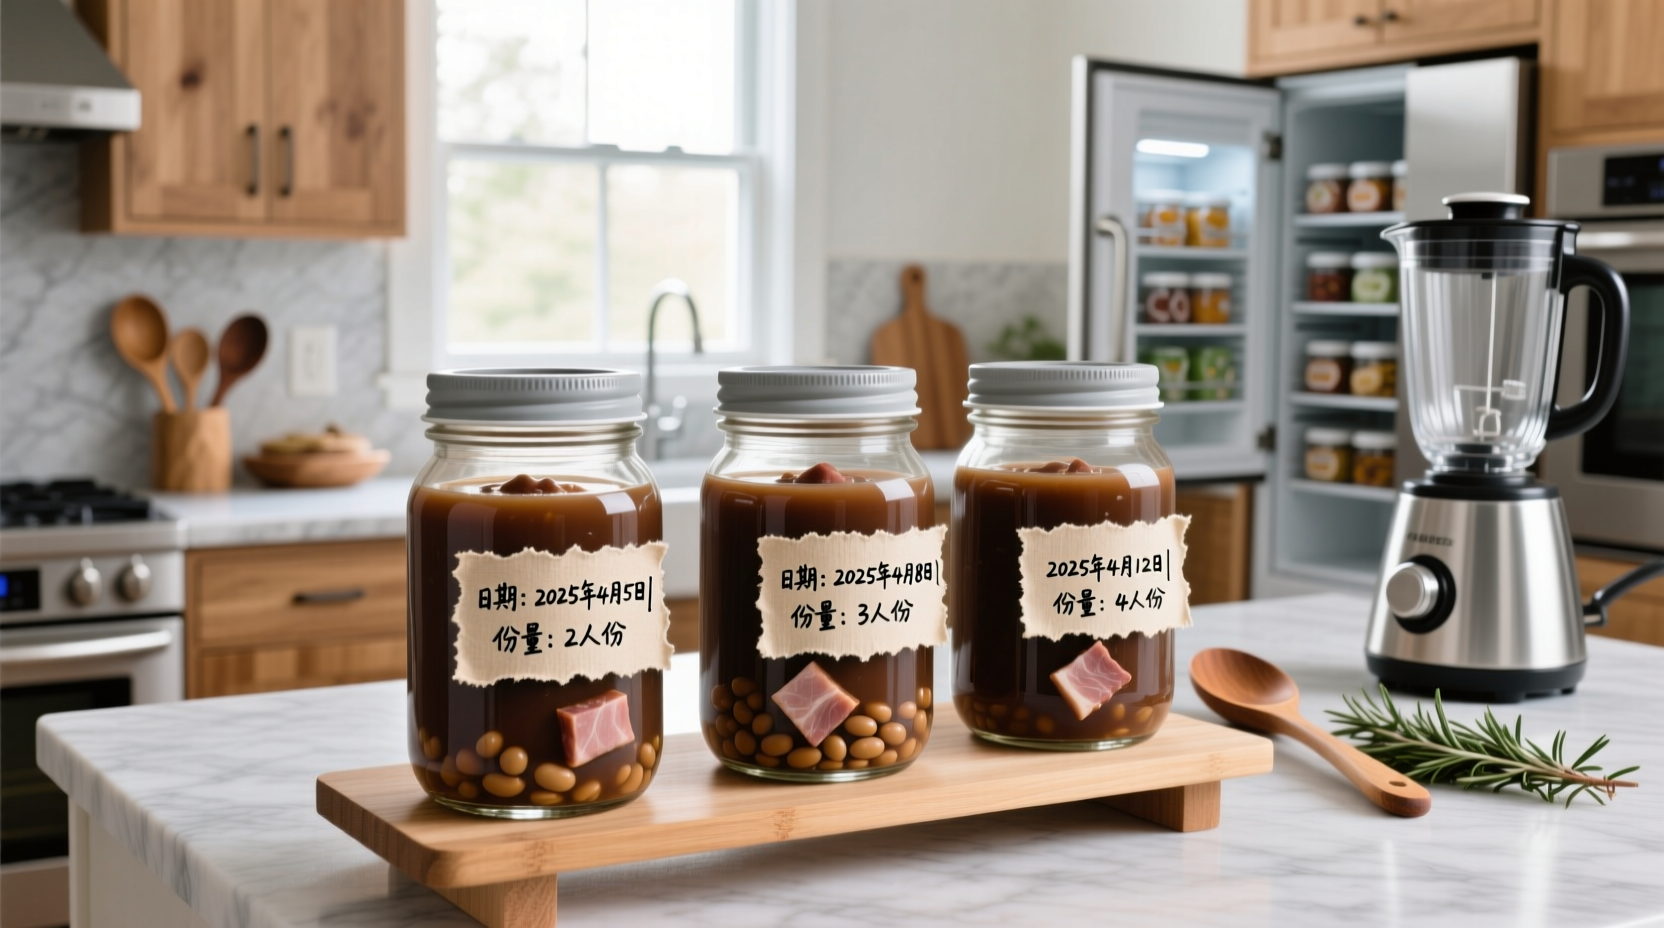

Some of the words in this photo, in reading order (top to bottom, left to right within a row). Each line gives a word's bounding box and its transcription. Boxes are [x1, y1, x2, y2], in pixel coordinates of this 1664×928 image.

[790, 599, 913, 631] 份量：3人份
[1053, 587, 1166, 617] 份量：4人份
[492, 621, 626, 655] 份量：2人份
